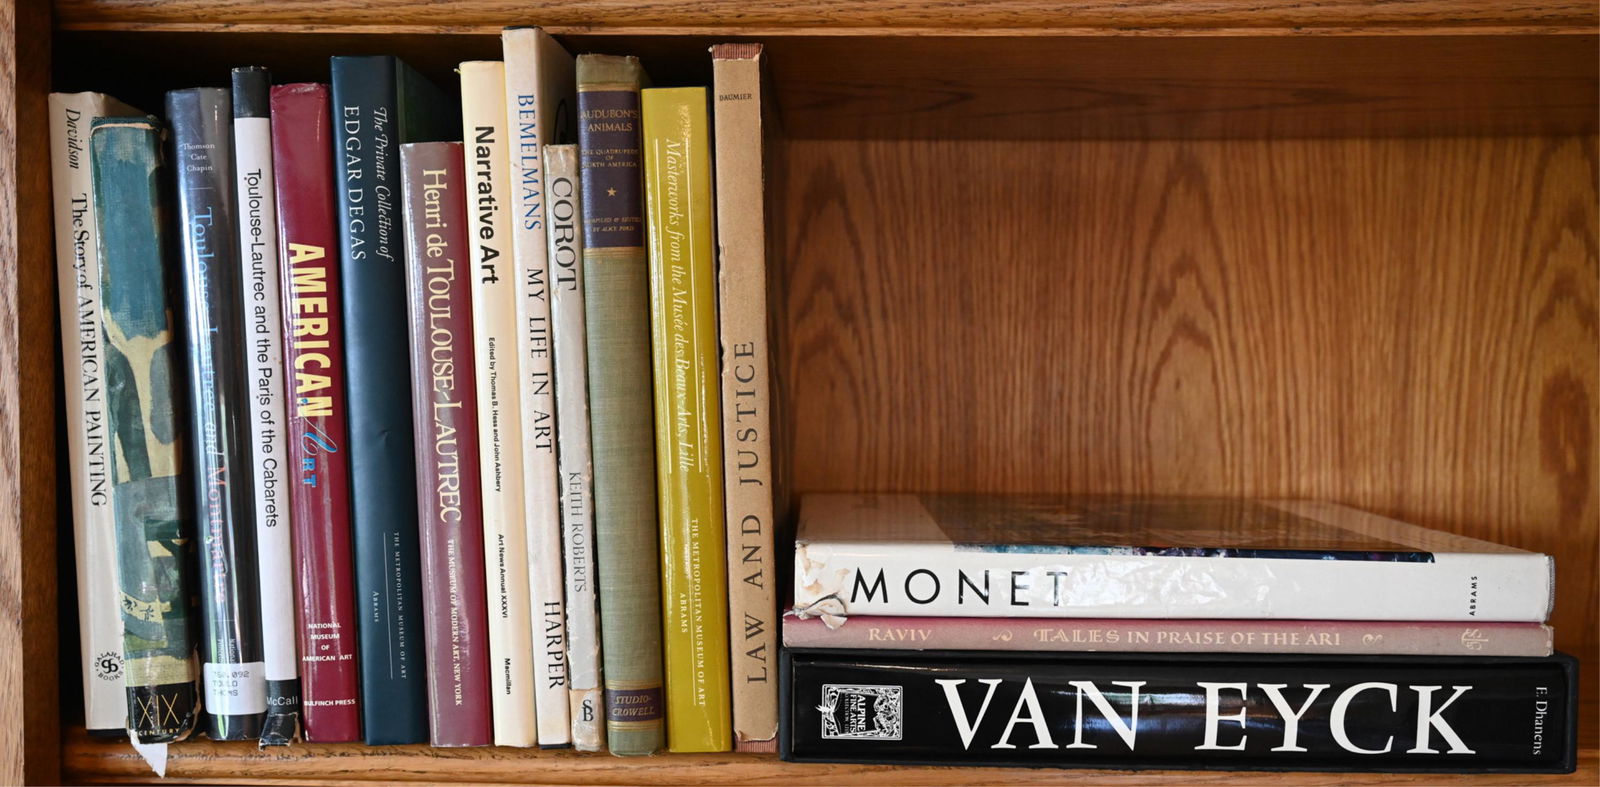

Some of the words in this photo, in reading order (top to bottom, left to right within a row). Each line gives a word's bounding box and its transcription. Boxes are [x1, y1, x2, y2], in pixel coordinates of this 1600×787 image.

[719, 93, 753, 101] DAUMIER
[373, 106, 389, 132] The
[588, 122, 633, 132] ANIMALS
[65, 108, 83, 170] Davidson
[183, 142, 216, 150] Thomson
[343, 106, 363, 182] EDGAR
[374, 133, 389, 181] Private
[186, 164, 213, 172] Chapin
[517, 94, 542, 231] BEMELMANS
[422, 168, 448, 229] Henri
[475, 126, 499, 240] Narrative
[665, 138, 683, 227] Masterworks
[71, 193, 88, 228] The
[348, 188, 367, 260] DEGAS
[374, 185, 393, 244] Collection
[73, 229, 90, 268] Story
[247, 168, 267, 301] Toulouse-Lautrec
[426, 233, 449, 258] de
[552, 177, 577, 291] COROT
[665, 226, 686, 264] from
[376, 246, 395, 262] of
[480, 244, 500, 284] Art
[76, 273, 93, 290] of
[527, 268, 545, 302] MY
[671, 266, 688, 285] the
[254, 305, 270, 334] and
[672, 286, 690, 331] Musée
[288, 243, 334, 417] AMERICAN
[488, 337, 496, 360] Edited
[529, 317, 548, 359] LIFE
[675, 332, 690, 354] des
[78, 296, 101, 402] AMERICAN
[256, 338, 272, 363] the
[489, 361, 496, 370] by
[258, 367, 274, 406] Paris
[426, 259, 463, 523] TOULOUSE-LAUTREC
[490, 372, 498, 400] Thomas
[532, 371, 550, 395] IN
[675, 356, 692, 437] Beaux-Arts,
[260, 410, 276, 426] of
[492, 400, 499, 409] B.
[734, 341, 764, 486] JUSTICE
[261, 430, 277, 454] the
[533, 410, 553, 454] ART
[85, 410, 108, 507] PAINTING
[679, 440, 695, 473] Lille
[262, 458, 279, 528] Cabarets
[494, 462, 502, 493] Ashbery
[568, 472, 584, 517] KEITH
[447, 539, 455, 555] THE
[571, 523, 587, 593] ROBERTS
[740, 513, 764, 591] AND
[394, 551, 404, 612] METROPOLITAN
[448, 555, 458, 594] MUSEUM
[692, 542, 703, 622] METROPOLITAN
[849, 566, 1069, 608] MONET
[451, 593, 458, 604] OF
[679, 592, 688, 634] ABRAMS
[1468, 575, 1479, 616] ABRAMS
[398, 615, 406, 648] MUSEUM
[450, 606, 460, 644] MODERN
[868, 627, 933, 642] RAVIV
[1033, 628, 1121, 644] TALES
[1127, 630, 1149, 644] IN
[1156, 630, 1225, 645] PRAISE
[1230, 631, 1256, 645] OF
[1261, 632, 1300, 646] THE
[1305, 632, 1341, 646] ARI
[302, 654, 336, 662] AMERICAN
[400, 651, 406, 661] OF
[544, 601, 566, 690] HARPER
[695, 624, 704, 669] MUSEUM
[744, 611, 768, 685] LAW
[453, 662, 462, 683] NEW
[504, 658, 512, 695] Macmillan
[697, 670, 705, 684] OF
[137, 693, 180, 728] XIX
[266, 695, 299, 706] McCall
[303, 699, 334, 707] BULFINCH
[335, 698, 356, 706] PRESS
[455, 682, 463, 706] YORK
[611, 706, 656, 717] CROWELL
[698, 686, 706, 706] ART
[849, 694, 858, 712] FINE
[849, 712, 858, 733] ARTS
[857, 694, 866, 732] ALPINE
[934, 676, 1147, 751] VAN
[1194, 682, 1477, 755] EYCK
[1532, 700, 1548, 756] Dhanens
[138, 727, 180, 737] CENTURY
